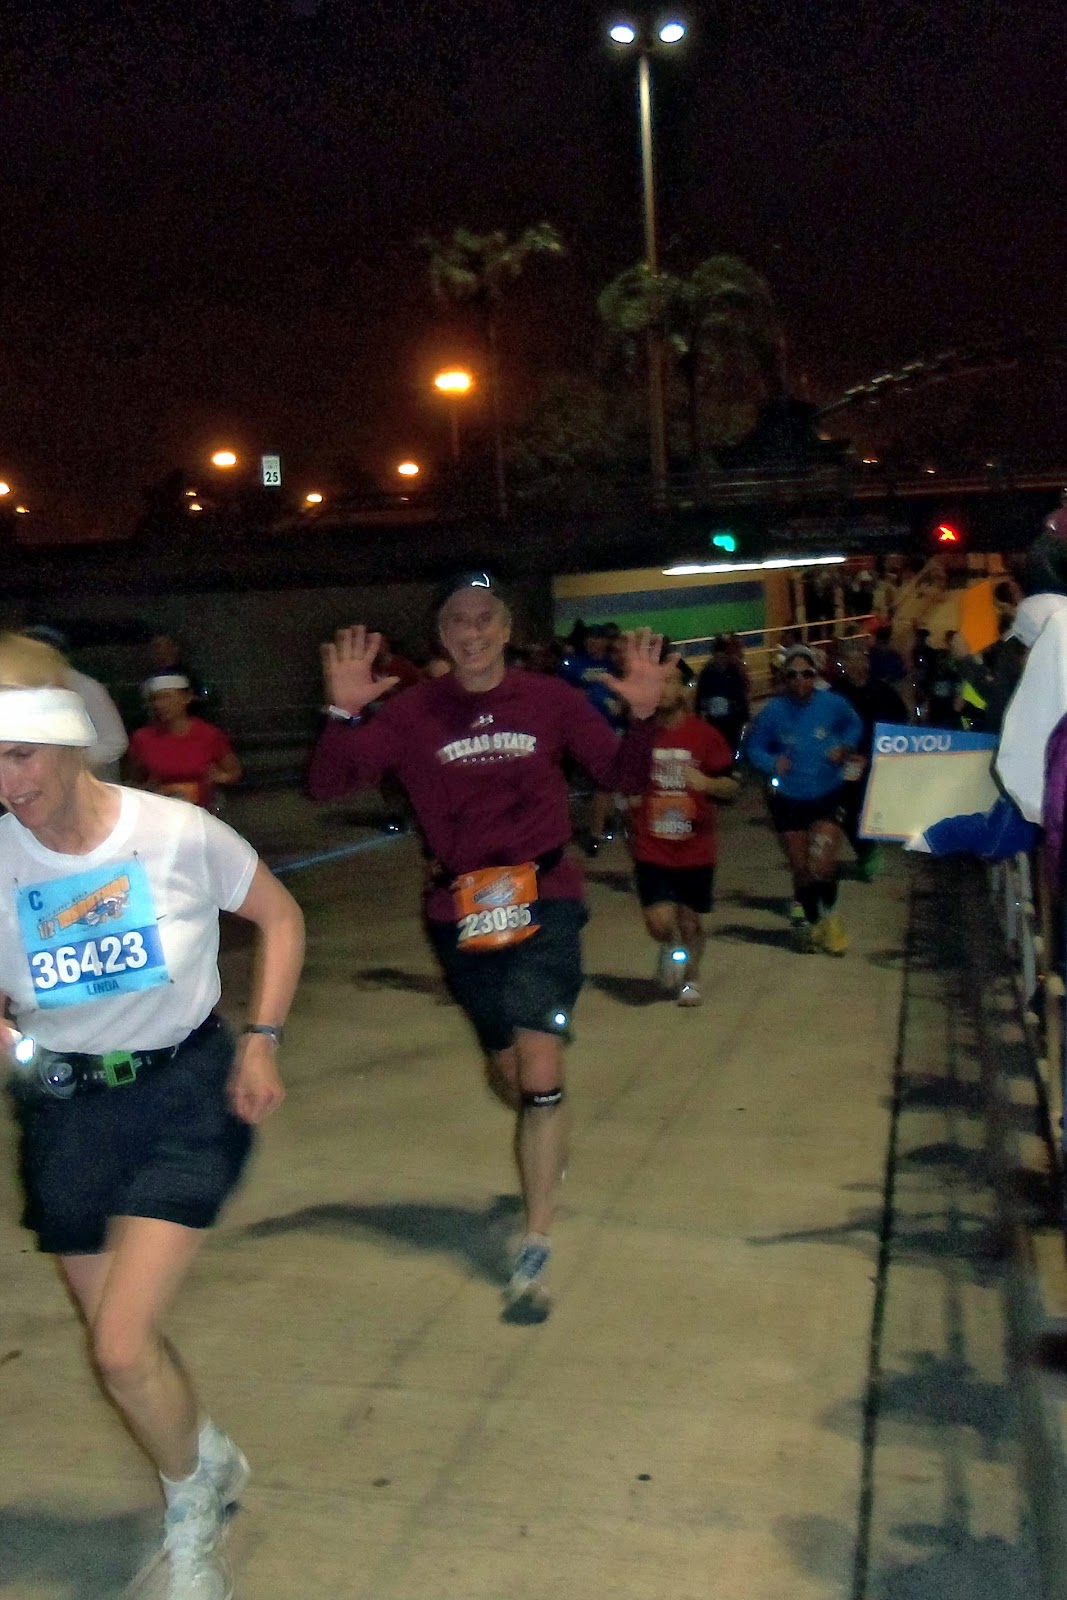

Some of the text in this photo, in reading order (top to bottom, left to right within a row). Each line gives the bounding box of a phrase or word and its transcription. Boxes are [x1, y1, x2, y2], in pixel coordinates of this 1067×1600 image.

[265, 471, 279, 483] 25
[441, 734, 490, 761] TEXAS
[493, 731, 537, 753] STATE
[876, 735, 951, 753] GO YOU
[28, 890, 44, 911] C
[462, 902, 532, 938] 23055
[31, 931, 148, 989] 36423
[86, 979, 120, 996] LINDA
